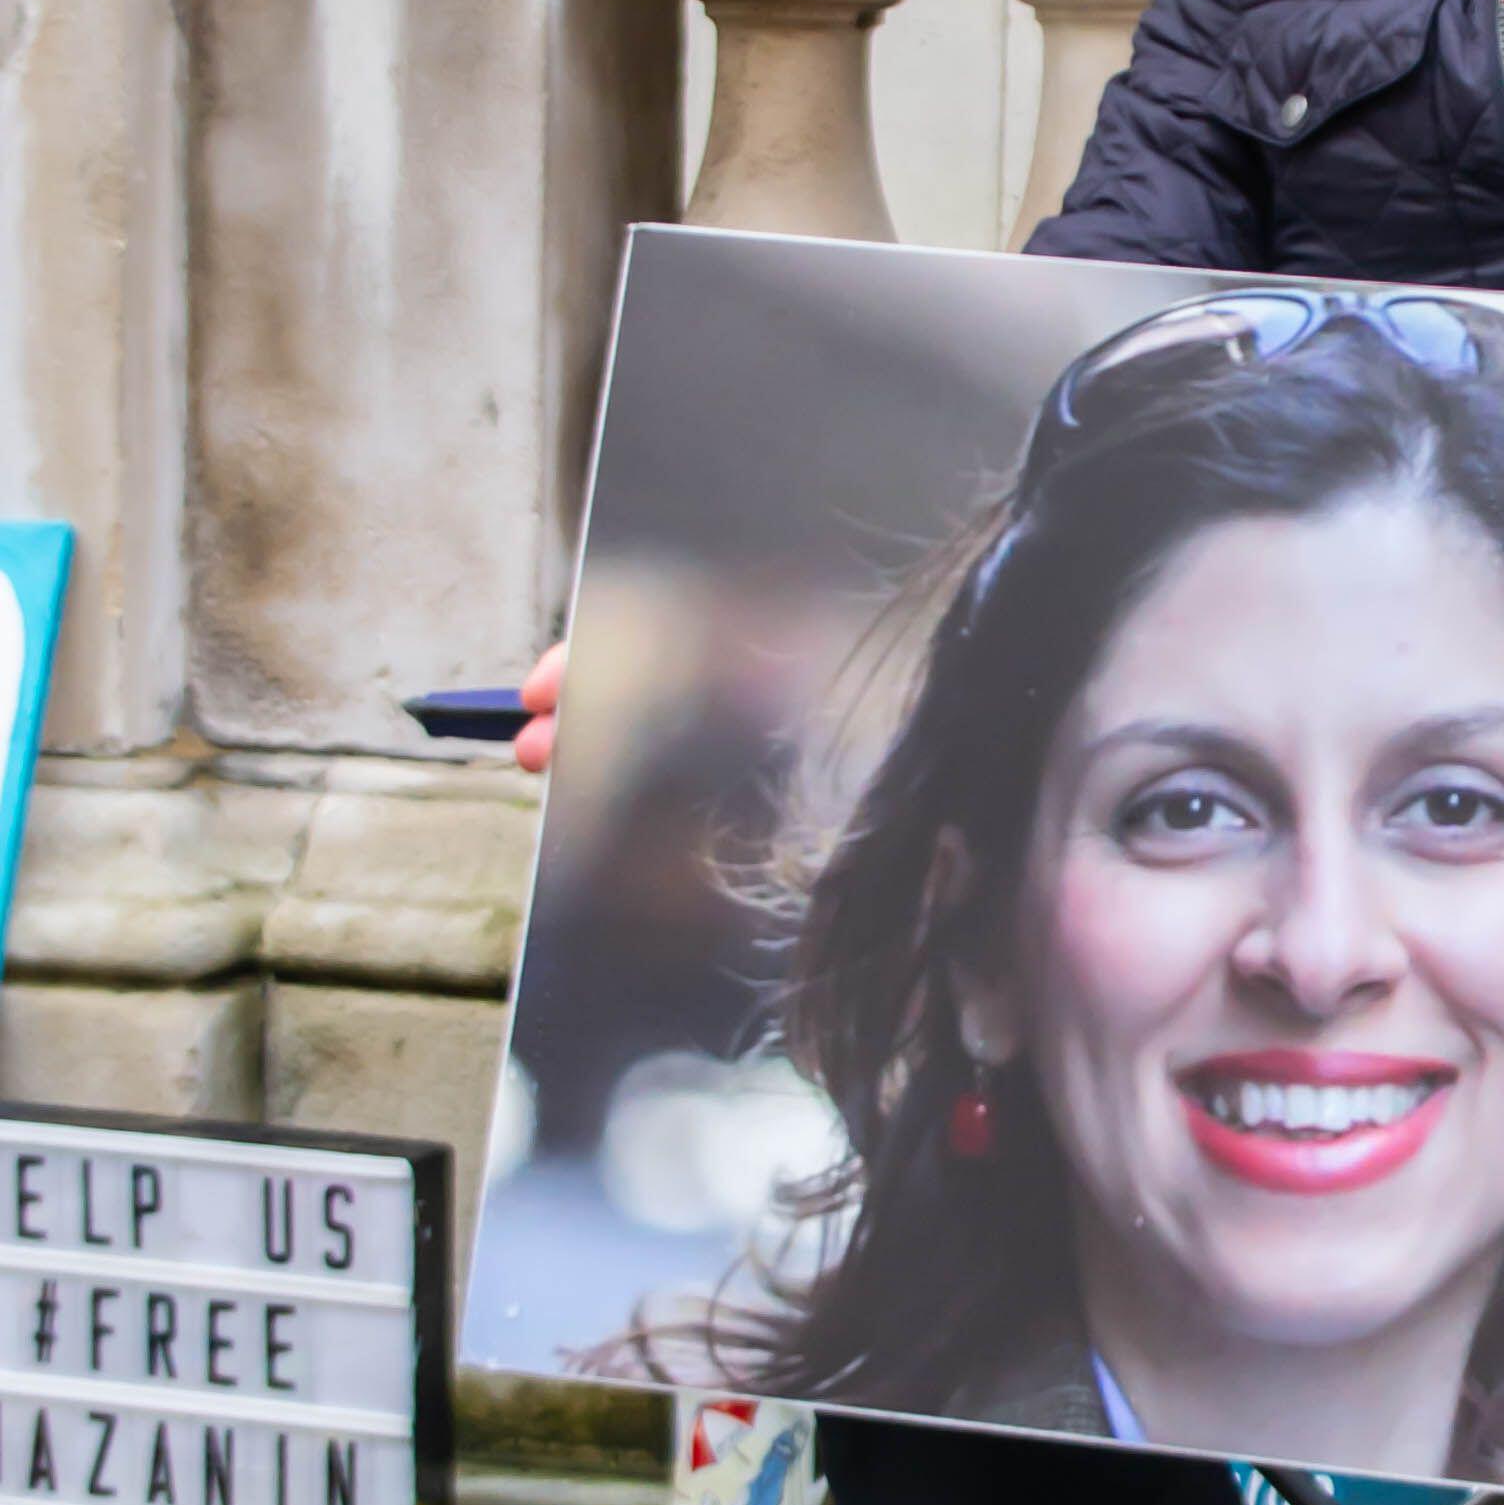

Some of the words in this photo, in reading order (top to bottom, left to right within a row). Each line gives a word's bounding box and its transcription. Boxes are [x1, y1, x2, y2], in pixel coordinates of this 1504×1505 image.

[16, 1155, 162, 1247] ELP
[262, 1177, 354, 1270] US
[34, 1279, 298, 1390] #FREE
